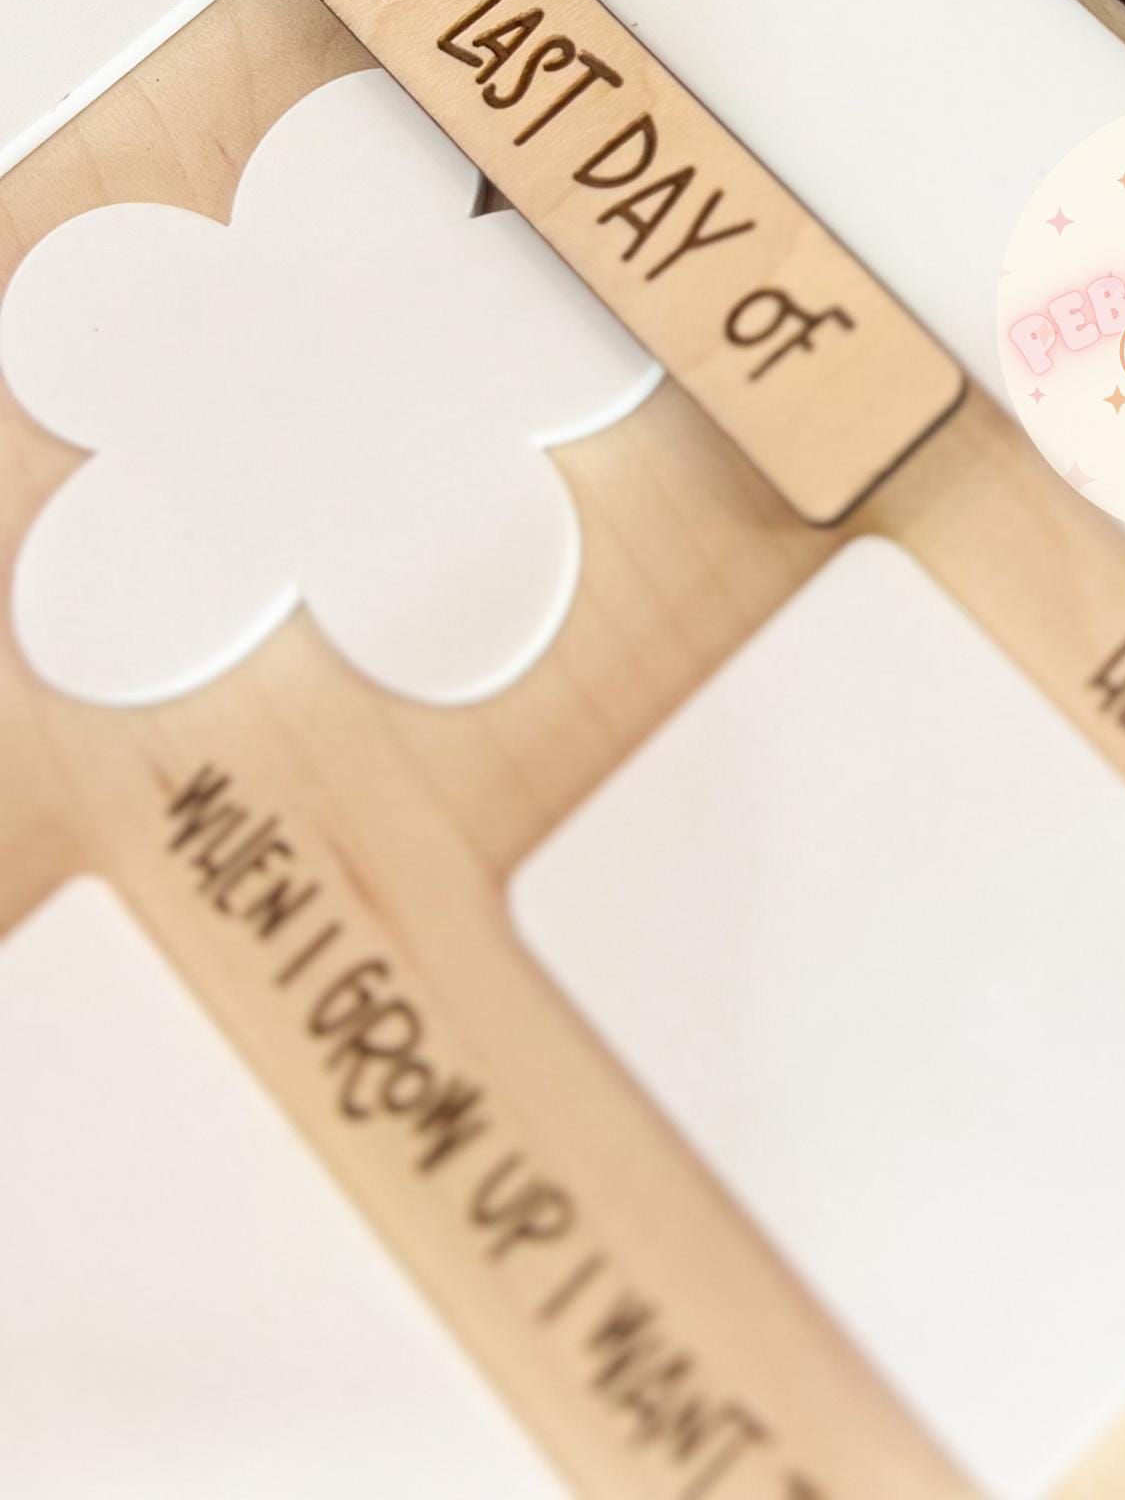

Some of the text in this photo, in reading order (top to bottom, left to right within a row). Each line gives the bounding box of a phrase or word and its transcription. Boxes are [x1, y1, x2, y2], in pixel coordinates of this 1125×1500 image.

[572, 111, 758, 283] DAY
[165, 761, 322, 942] WHEN
[275, 920, 342, 991] I
[305, 956, 492, 1177] GROW
[465, 1150, 580, 1265] UP
[534, 1250, 611, 1326] I
